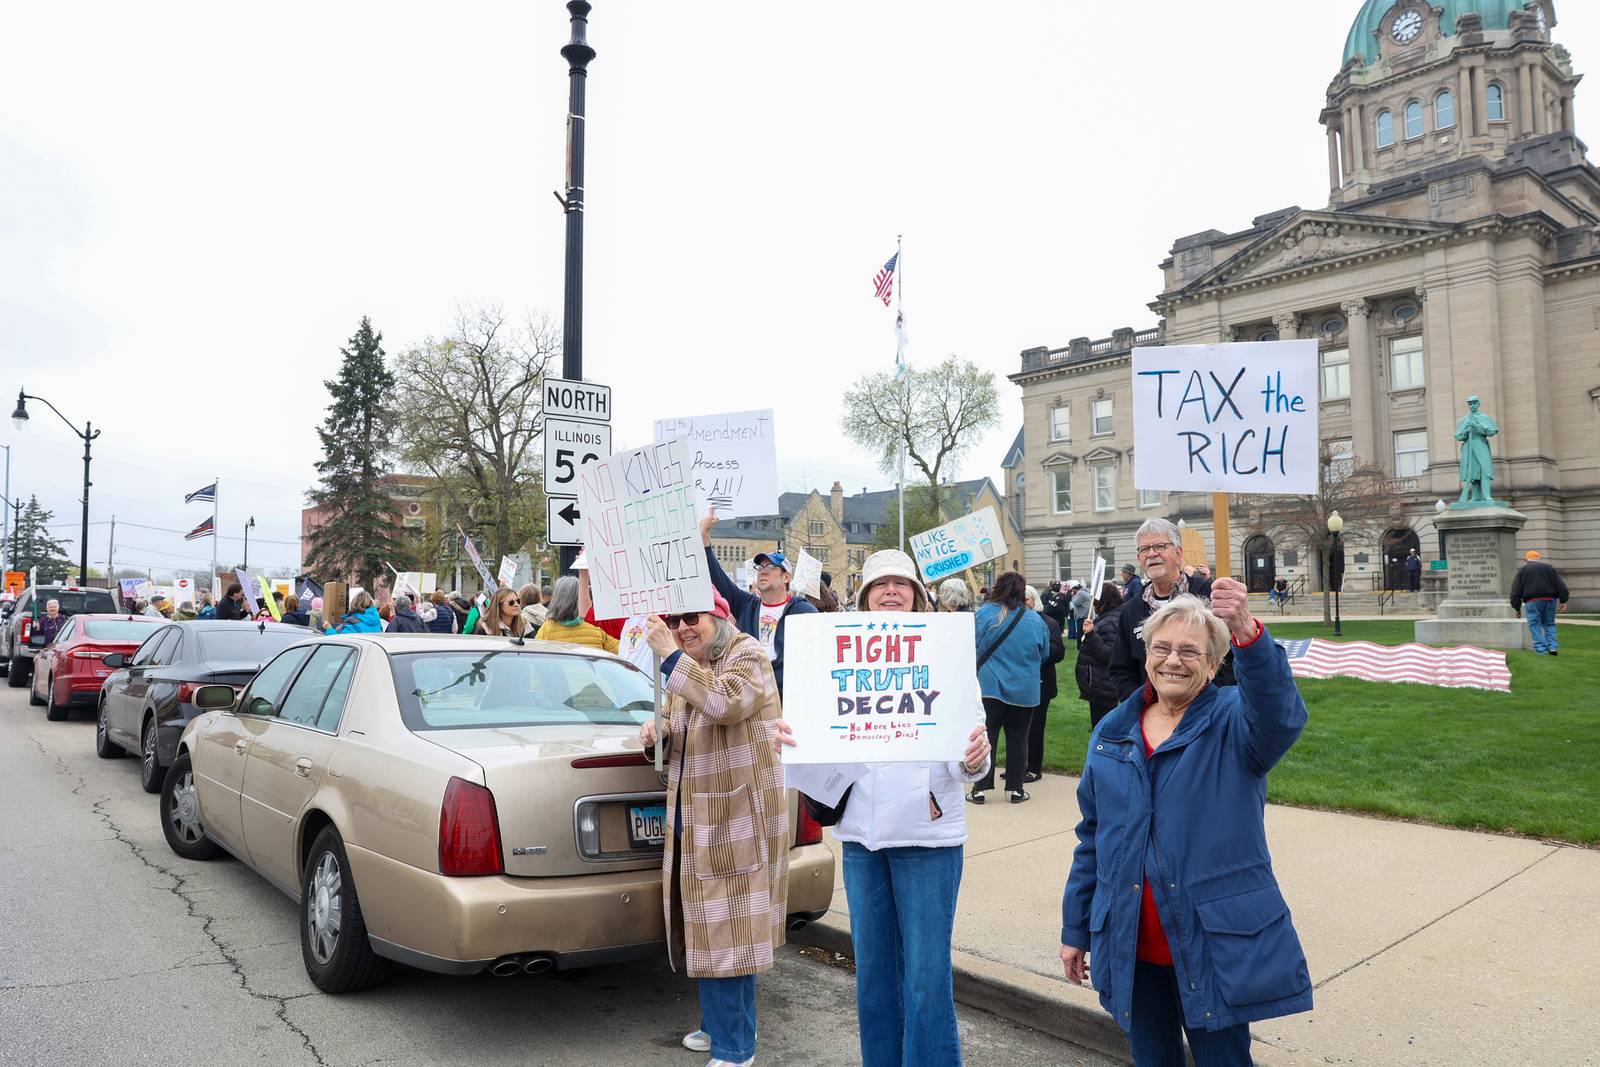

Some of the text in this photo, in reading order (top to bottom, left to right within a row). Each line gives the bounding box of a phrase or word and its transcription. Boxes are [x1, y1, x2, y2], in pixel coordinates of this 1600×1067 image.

[547, 386, 607, 414] NORTH
[1137, 366, 1306, 424] TAX the
[554, 430, 602, 445] ILLINOIS
[1177, 424, 1289, 476] RICH
[581, 440, 684, 504] NO KINGS
[691, 450, 740, 470] Process
[588, 506, 624, 550] NO
[913, 529, 948, 549] I LIKE
[594, 536, 700, 592] NO NAZIS
[917, 540, 958, 563] MY ICE
[925, 553, 969, 577] CRUSHED
[836, 634, 922, 664] FIGHT
[830, 665, 929, 692] TRUTH
[837, 690, 941, 716] DECAY
[849, 721, 912, 732] No More Lies
[849, 733, 891, 744] Democracy
[895, 729, 919, 741] Dies!
[635, 815, 666, 839] PUGL
